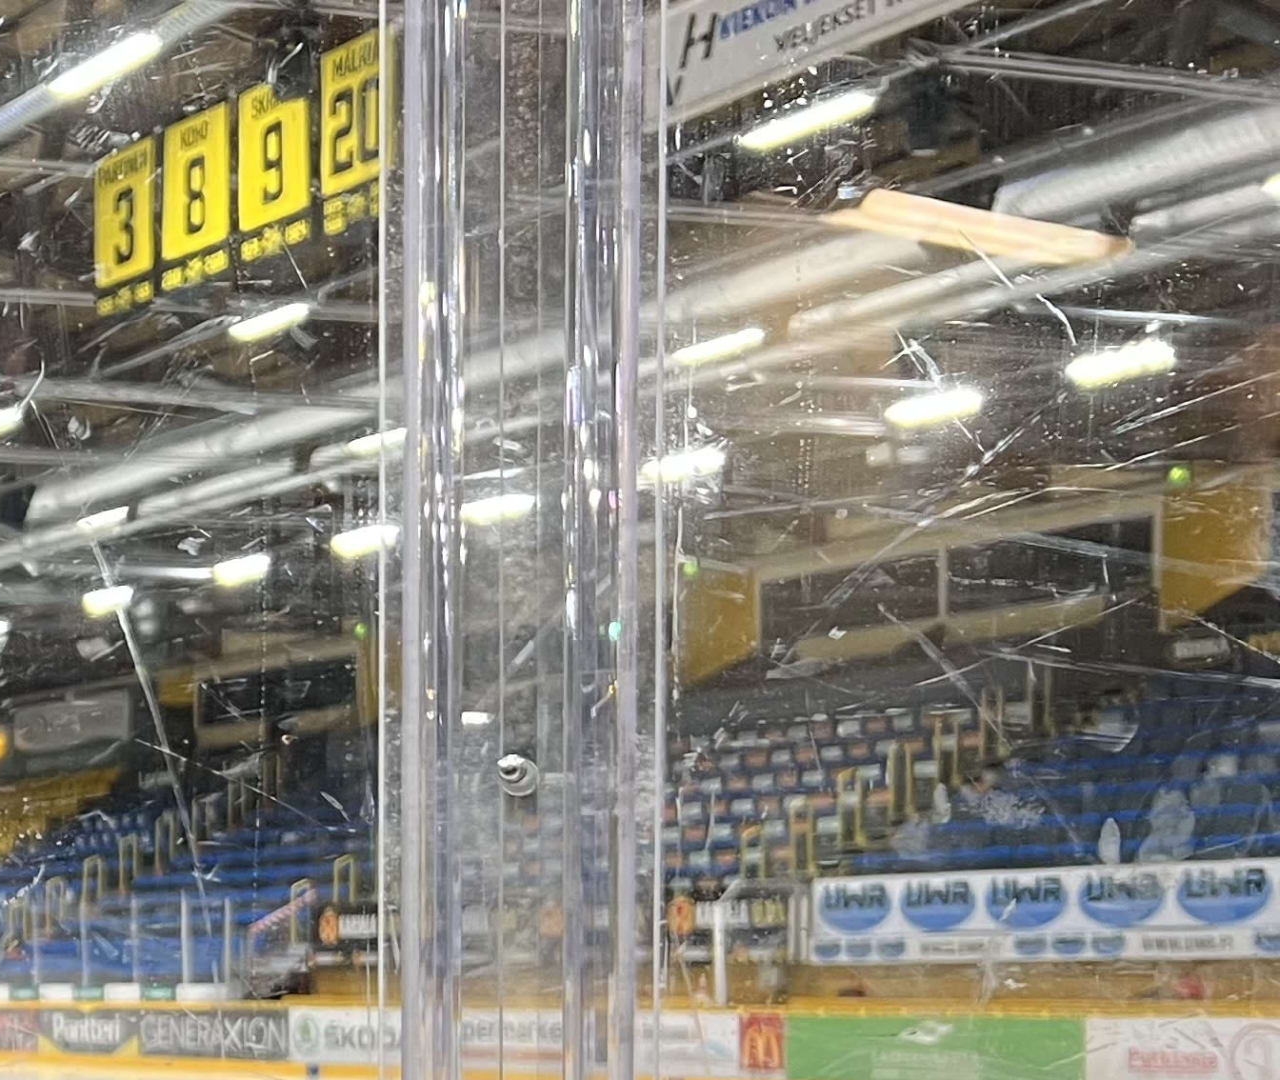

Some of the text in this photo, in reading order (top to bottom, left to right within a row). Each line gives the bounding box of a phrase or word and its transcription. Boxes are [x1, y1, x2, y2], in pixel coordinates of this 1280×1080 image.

[262, 119, 283, 206] 9
[186, 155, 206, 235] 8
[114, 187, 134, 265] 3
[822, 884, 888, 908] UWR
[906, 880, 971, 906] UWR
[990, 876, 1062, 902] UWR
[142, 1013, 286, 1052] GENERAXION
